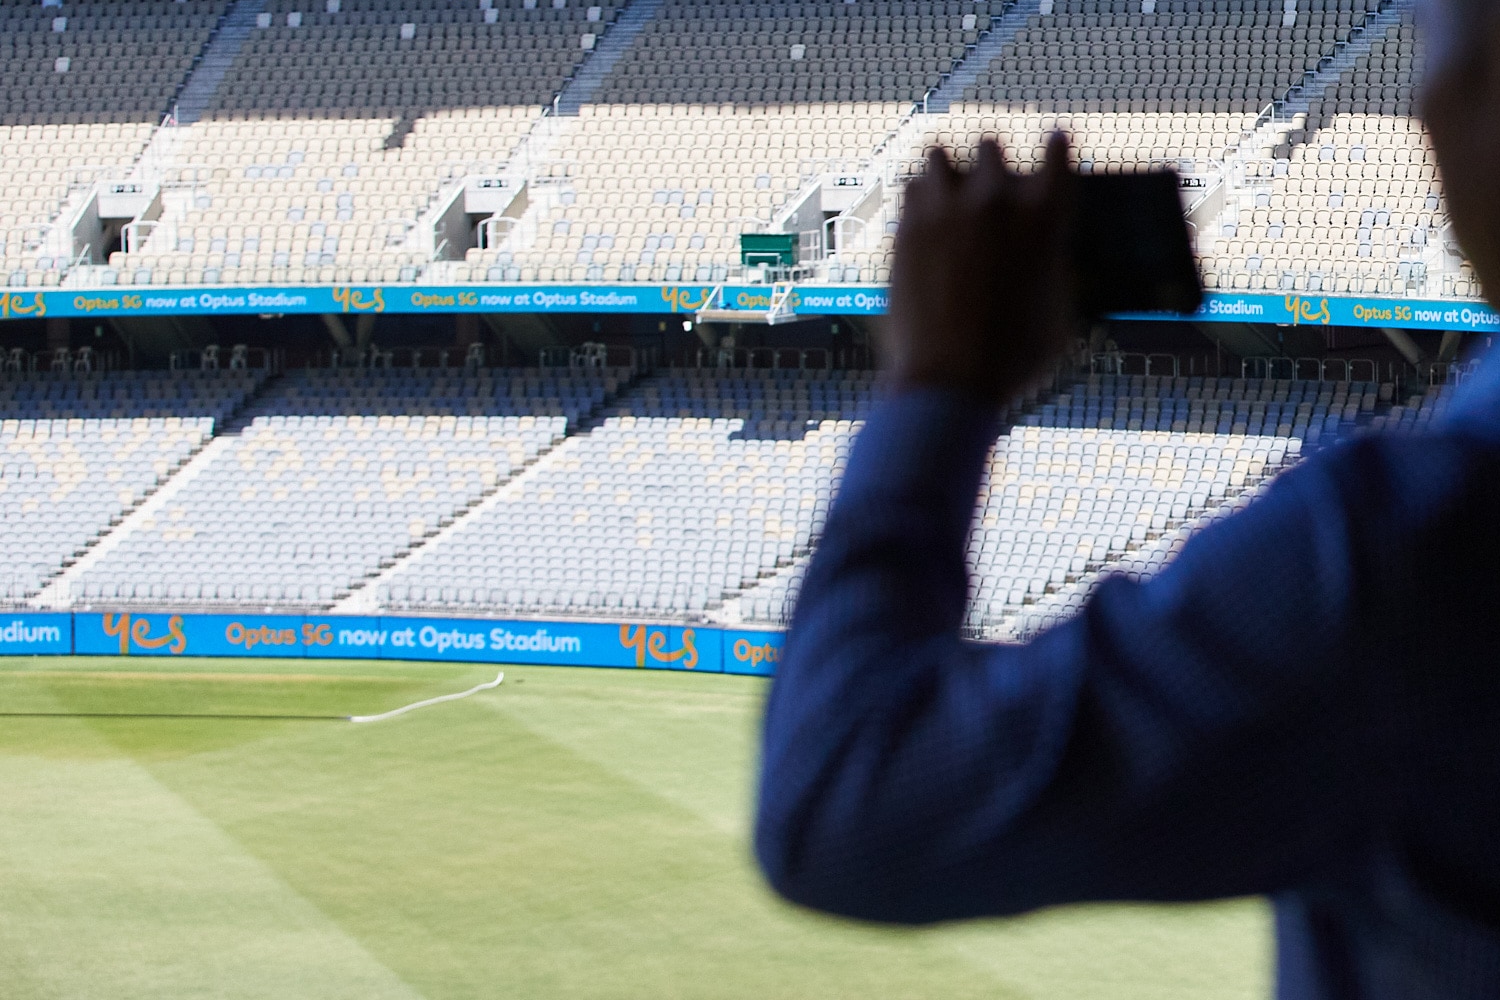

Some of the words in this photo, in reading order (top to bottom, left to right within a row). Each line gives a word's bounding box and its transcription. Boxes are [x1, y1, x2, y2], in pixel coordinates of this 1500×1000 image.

[73, 294, 119, 312] Optus
[122, 294, 143, 309] 5G
[145, 298, 177, 308] now
[180, 296, 196, 308] at
[199, 293, 245, 308] Optus
[248, 292, 306, 307] Stadium
[332, 287, 385, 313] yes
[411, 291, 455, 308] Optus
[457, 291, 478, 306] 5G
[481, 295, 511, 305] now
[514, 293, 530, 305] at
[532, 291, 577, 308] Optus
[580, 291, 637, 306] Stadium
[736, 291, 779, 309] Optu
[804, 296, 834, 307] now
[836, 294, 852, 307] at
[854, 292, 889, 310] Optu
[1209, 299, 1263, 315] Stadium
[1284, 295, 1331, 326] yes
[1353, 304, 1393, 322] Optus
[1395, 305, 1412, 321] 5G
[1414, 310, 1442, 322] now
[1444, 309, 1459, 322] at
[1461, 308, 1500, 327] Optus
[0, 620, 60, 643] dium
[102, 613, 187, 655] yes
[225, 622, 296, 650] Optus
[301, 623, 334, 646] 5G
[338, 630, 387, 646] now
[391, 626, 416, 647] at
[419, 626, 485, 653] Optus
[490, 627, 580, 653] Stadium
[619, 624, 699, 669] yes
[733, 638, 783, 668] Optu
